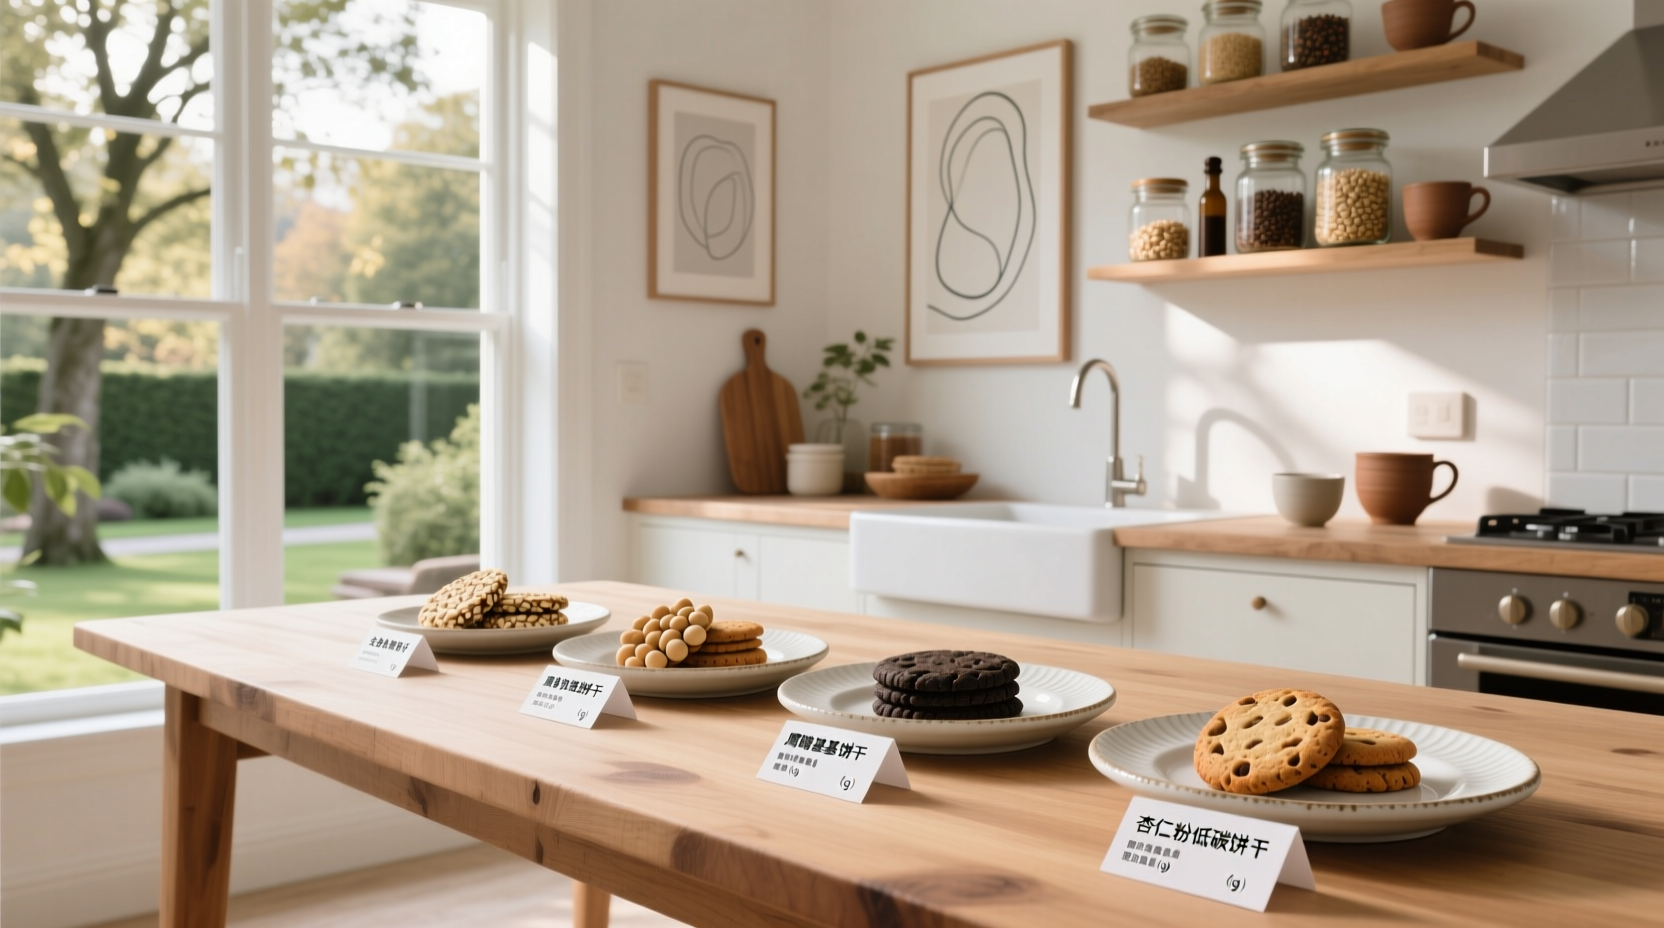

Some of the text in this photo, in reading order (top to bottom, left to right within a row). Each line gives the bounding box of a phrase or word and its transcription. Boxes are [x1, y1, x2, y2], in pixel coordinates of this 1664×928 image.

[839, 775, 856, 791] (g)
[1136, 815, 1270, 859] 杏仁粉低碳饼干
[1226, 874, 1247, 893] (g)
